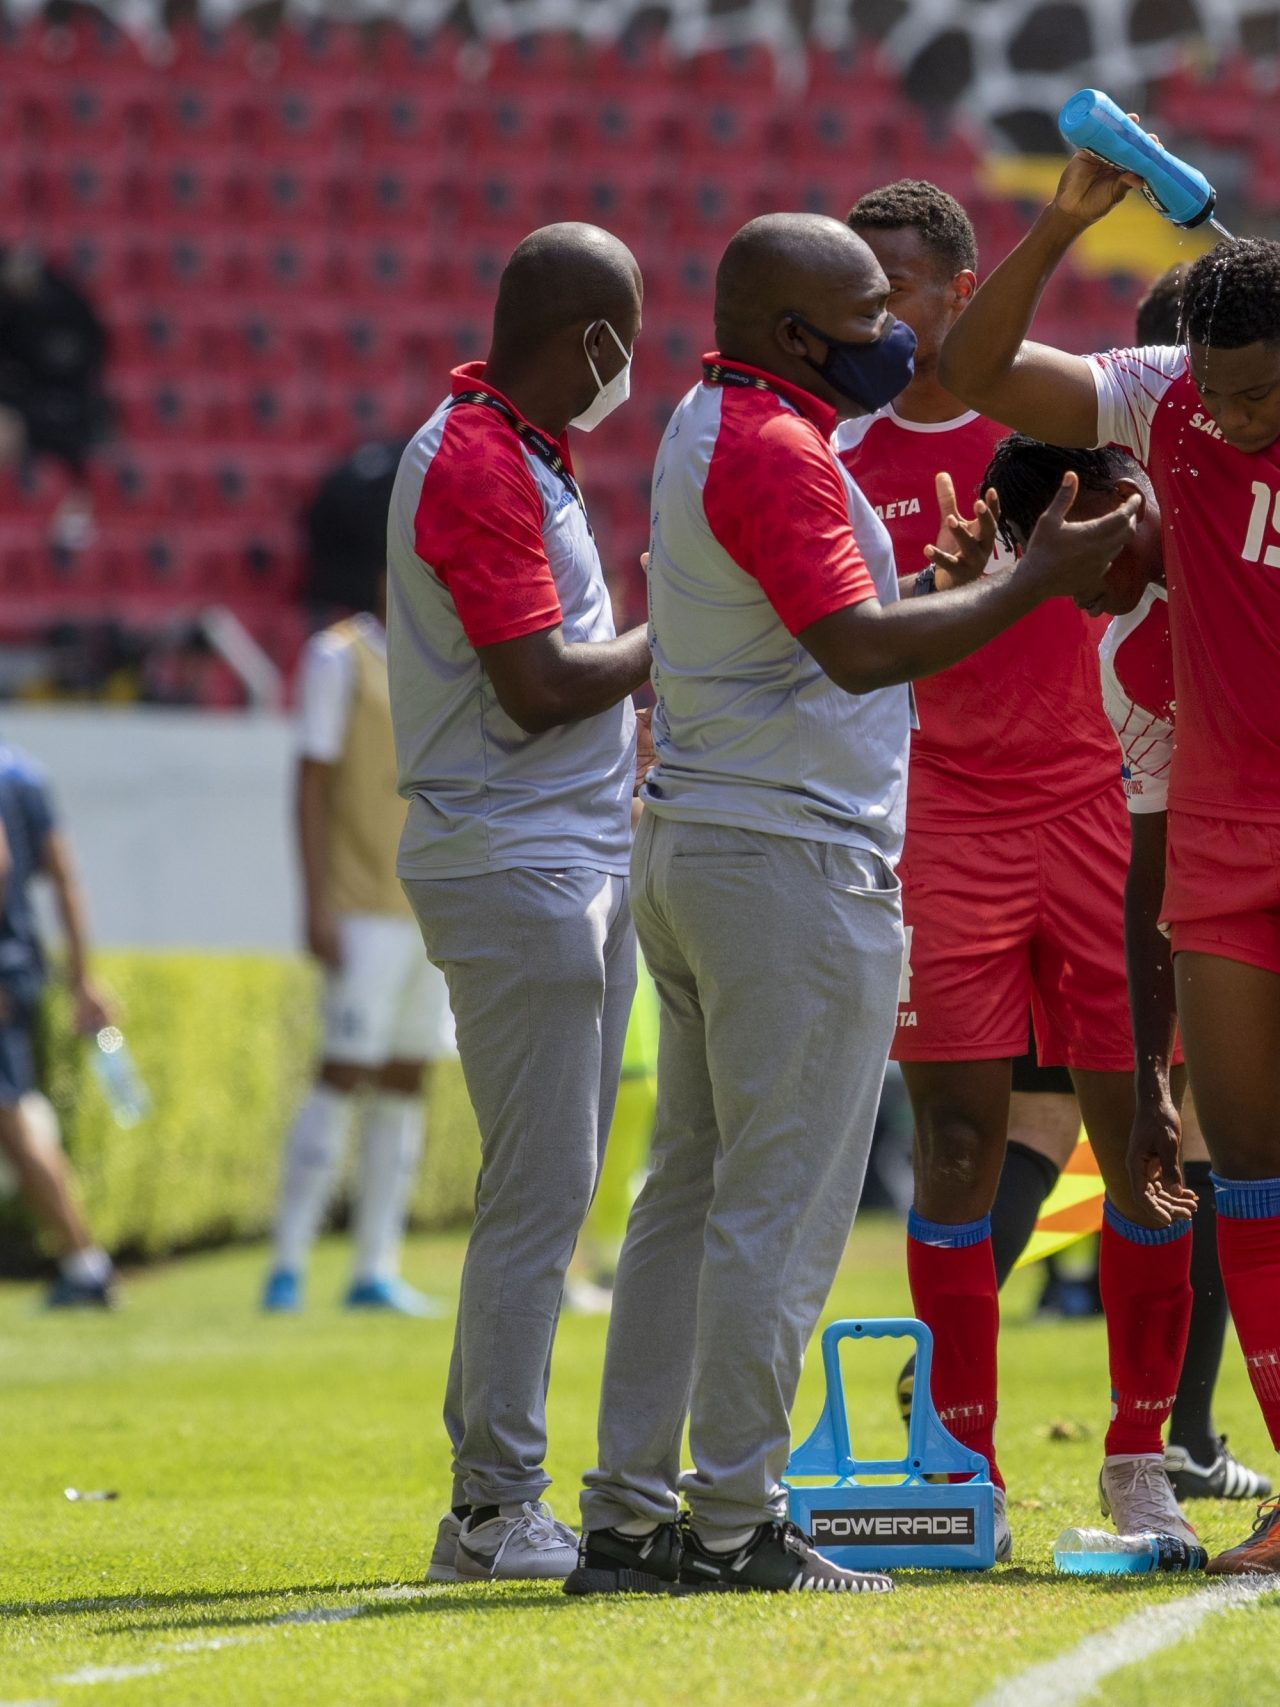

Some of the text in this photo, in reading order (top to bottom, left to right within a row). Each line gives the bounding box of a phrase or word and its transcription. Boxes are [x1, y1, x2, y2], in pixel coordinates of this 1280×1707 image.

[1188, 412, 1223, 440] SAE
[873, 498, 921, 521] AETA
[812, 1516, 968, 1536] POWERADE
